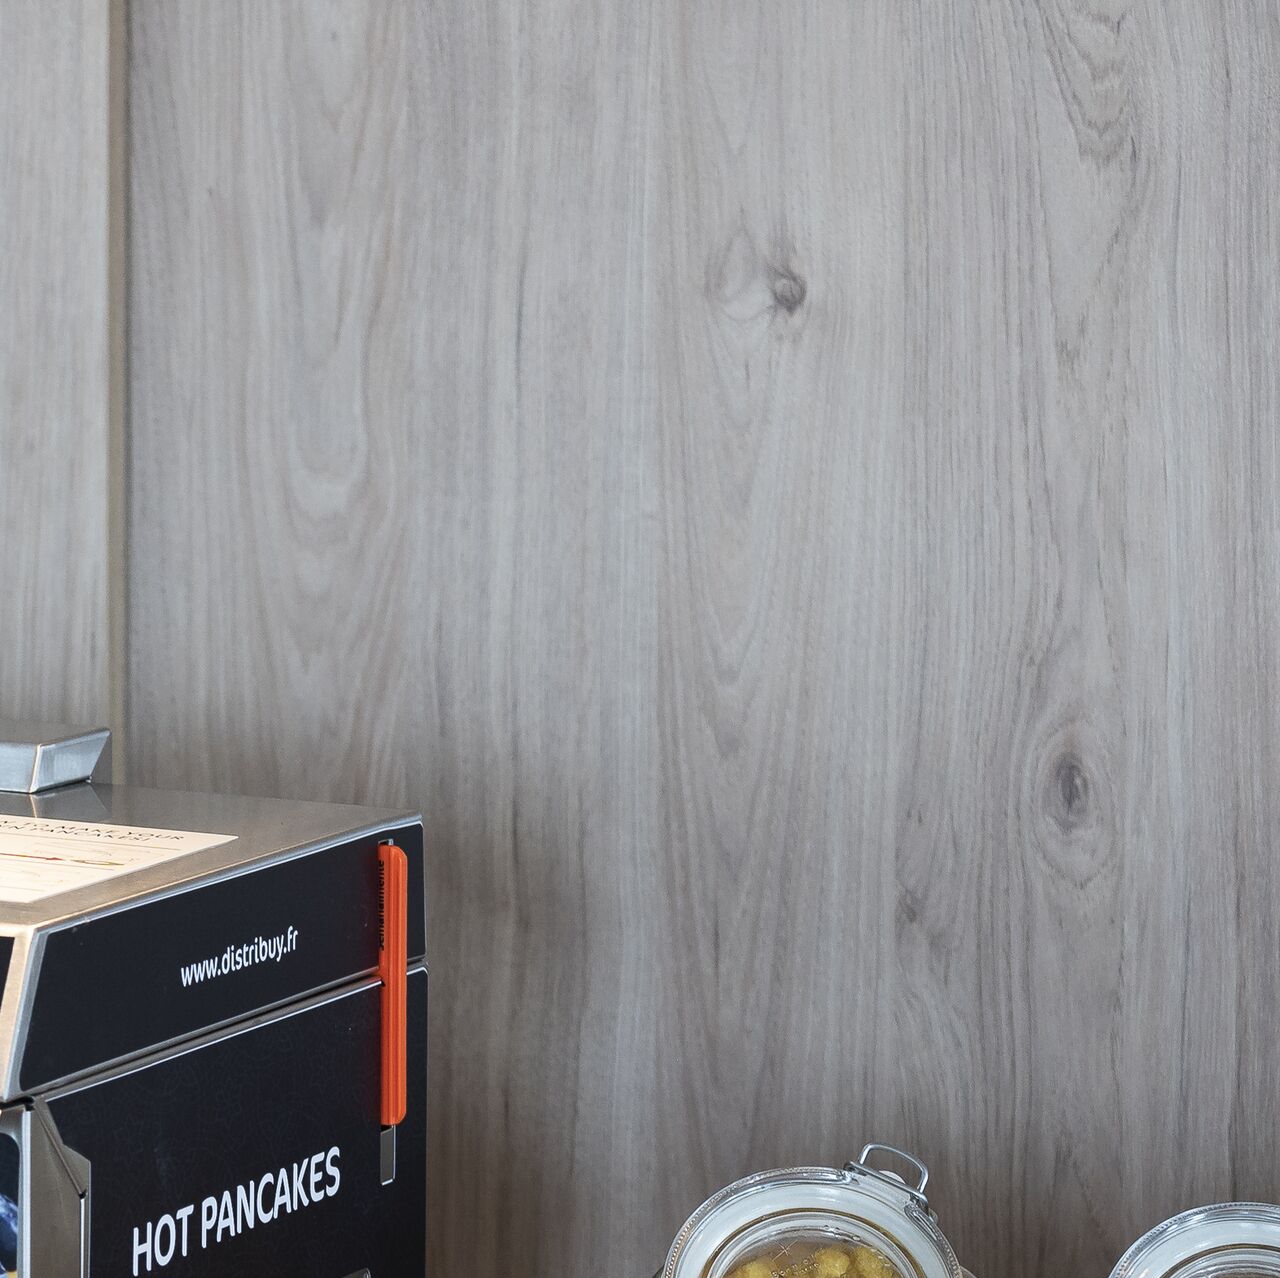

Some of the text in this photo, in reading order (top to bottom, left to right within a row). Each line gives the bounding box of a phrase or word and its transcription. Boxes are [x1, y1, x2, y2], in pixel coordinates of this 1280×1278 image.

[180, 925, 299, 988] www.distribuy.fr
[132, 1145, 341, 1277] HOT PANCAKES
